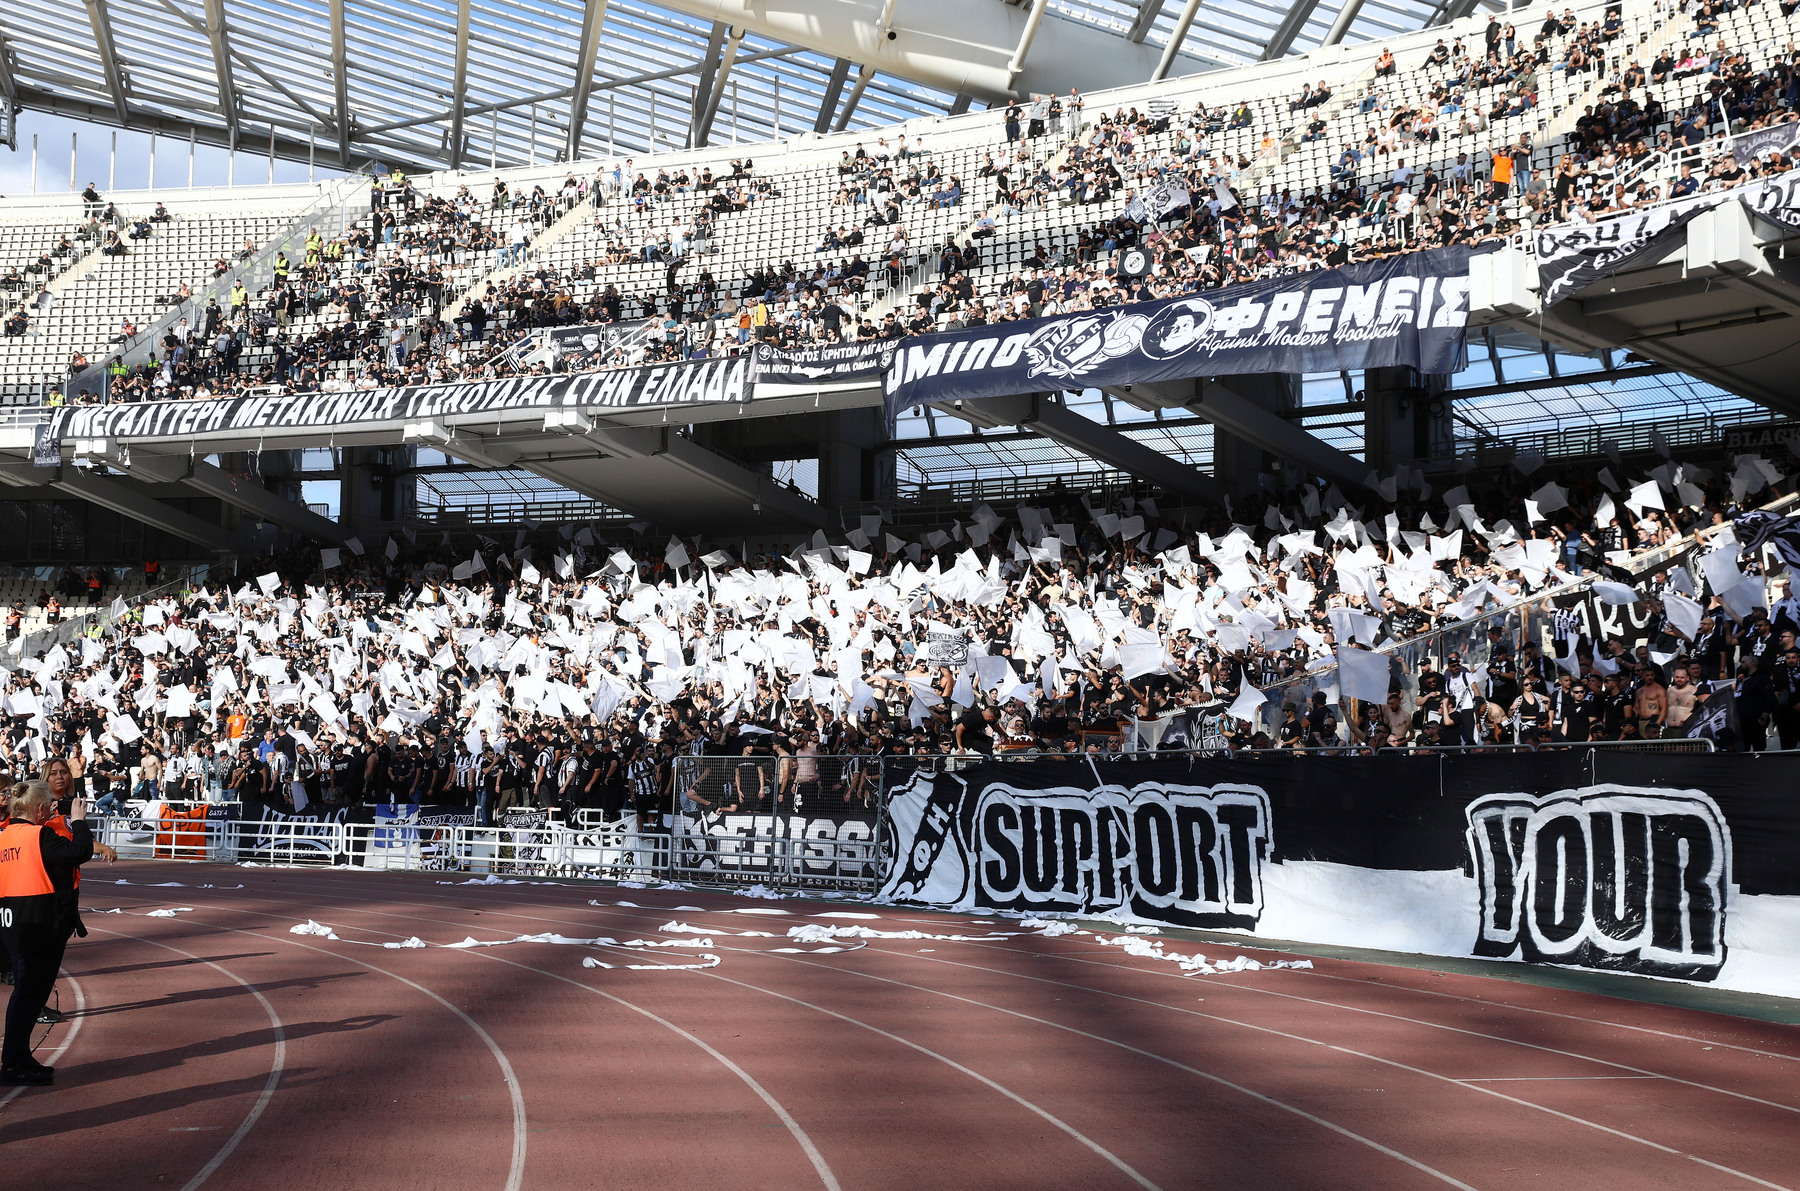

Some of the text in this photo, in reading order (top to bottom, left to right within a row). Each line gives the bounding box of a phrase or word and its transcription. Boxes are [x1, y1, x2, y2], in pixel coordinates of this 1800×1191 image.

[1198, 314, 1406, 358] Against Modern Football
[755, 363, 771, 373] ΕΝΑ
[835, 362, 851, 373] ΜΙΑ
[48, 407, 71, 440] Η
[66, 400, 235, 437] ΜΕΓΑΛΥΤΕΡΗ
[637, 358, 747, 404] ΕΛΛΑΔΑ
[257, 804, 349, 851] ULTRAS
[420, 813, 475, 827] STAVRAKIA
[979, 792, 1267, 912] SUPPORT
[1470, 796, 1724, 964] YOUR
